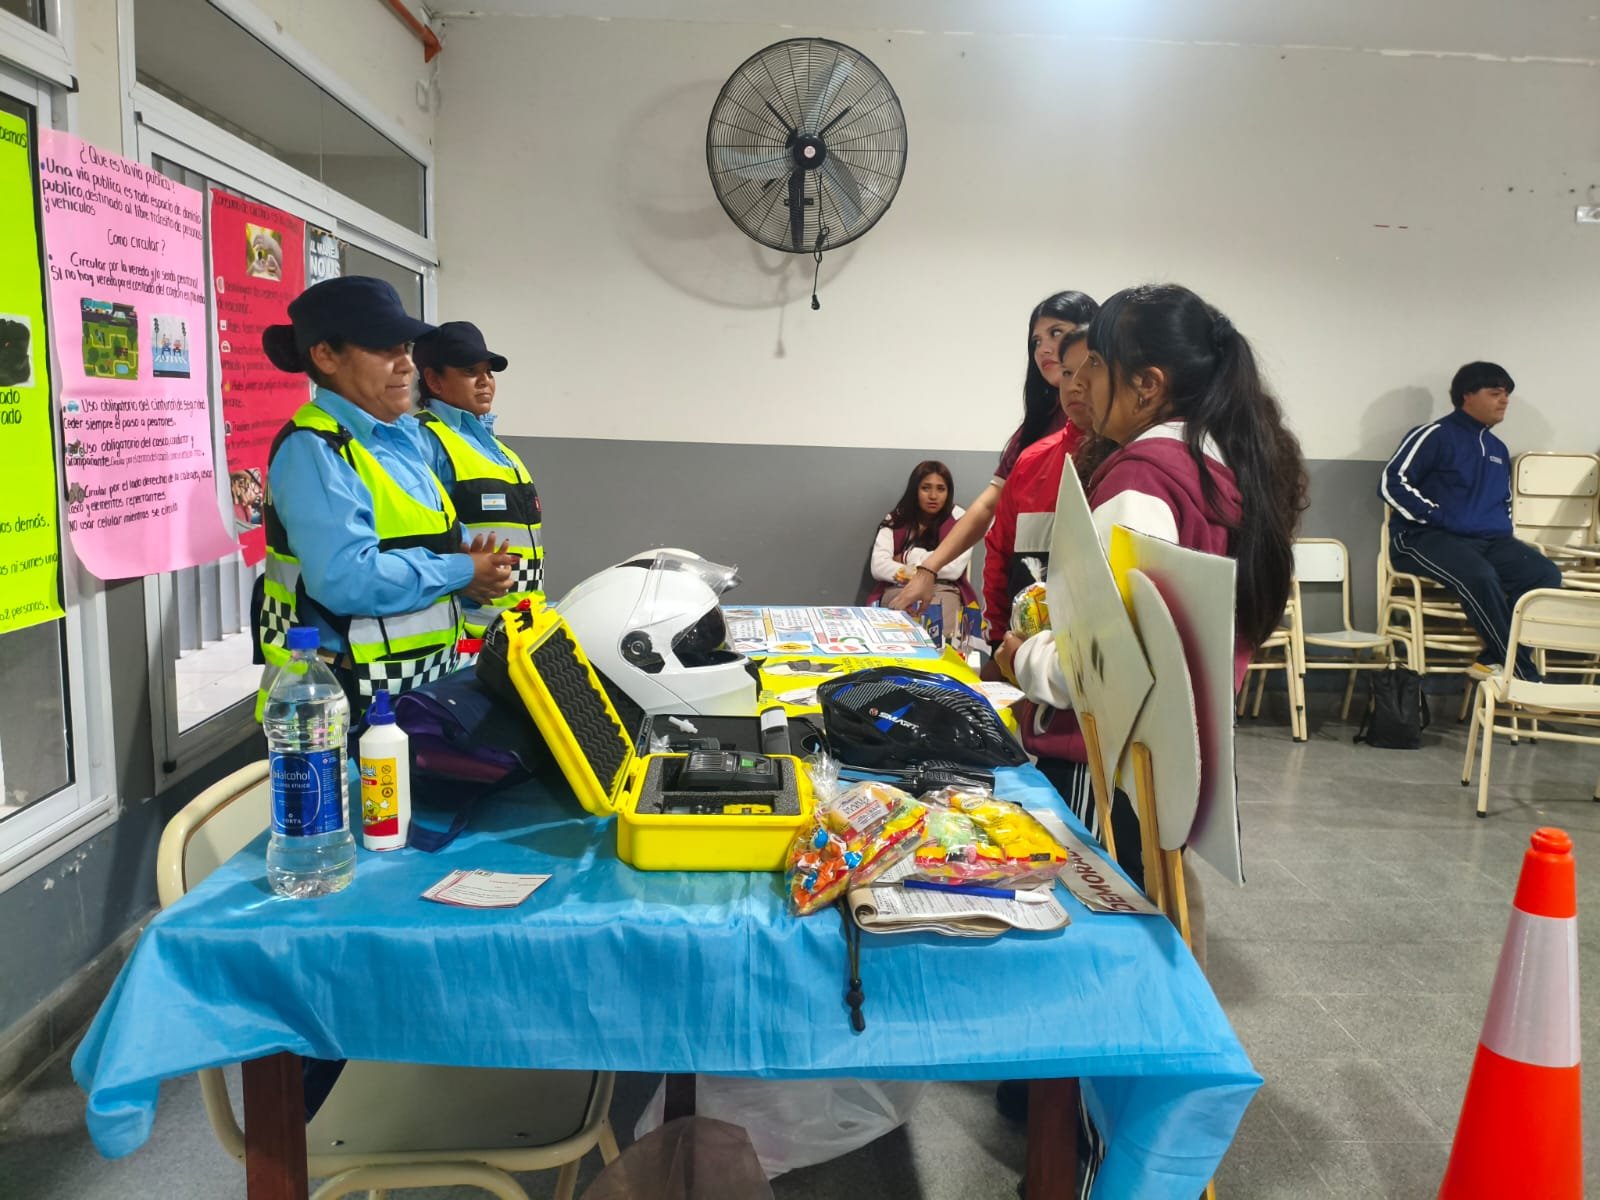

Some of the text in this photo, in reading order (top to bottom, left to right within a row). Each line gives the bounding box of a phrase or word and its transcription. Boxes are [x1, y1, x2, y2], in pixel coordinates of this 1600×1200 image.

[46, 157, 73, 177] Una
[70, 251, 107, 271] Circular
[65, 269, 76, 280] no
[77, 269, 94, 287] hay
[81, 398, 98, 413] Uso
[100, 398, 138, 420] obligatorio
[86, 418, 113, 435] siempre
[101, 437, 140, 457] obligatorio
[80, 520, 95, 530] usar
[97, 515, 123, 529] celular
